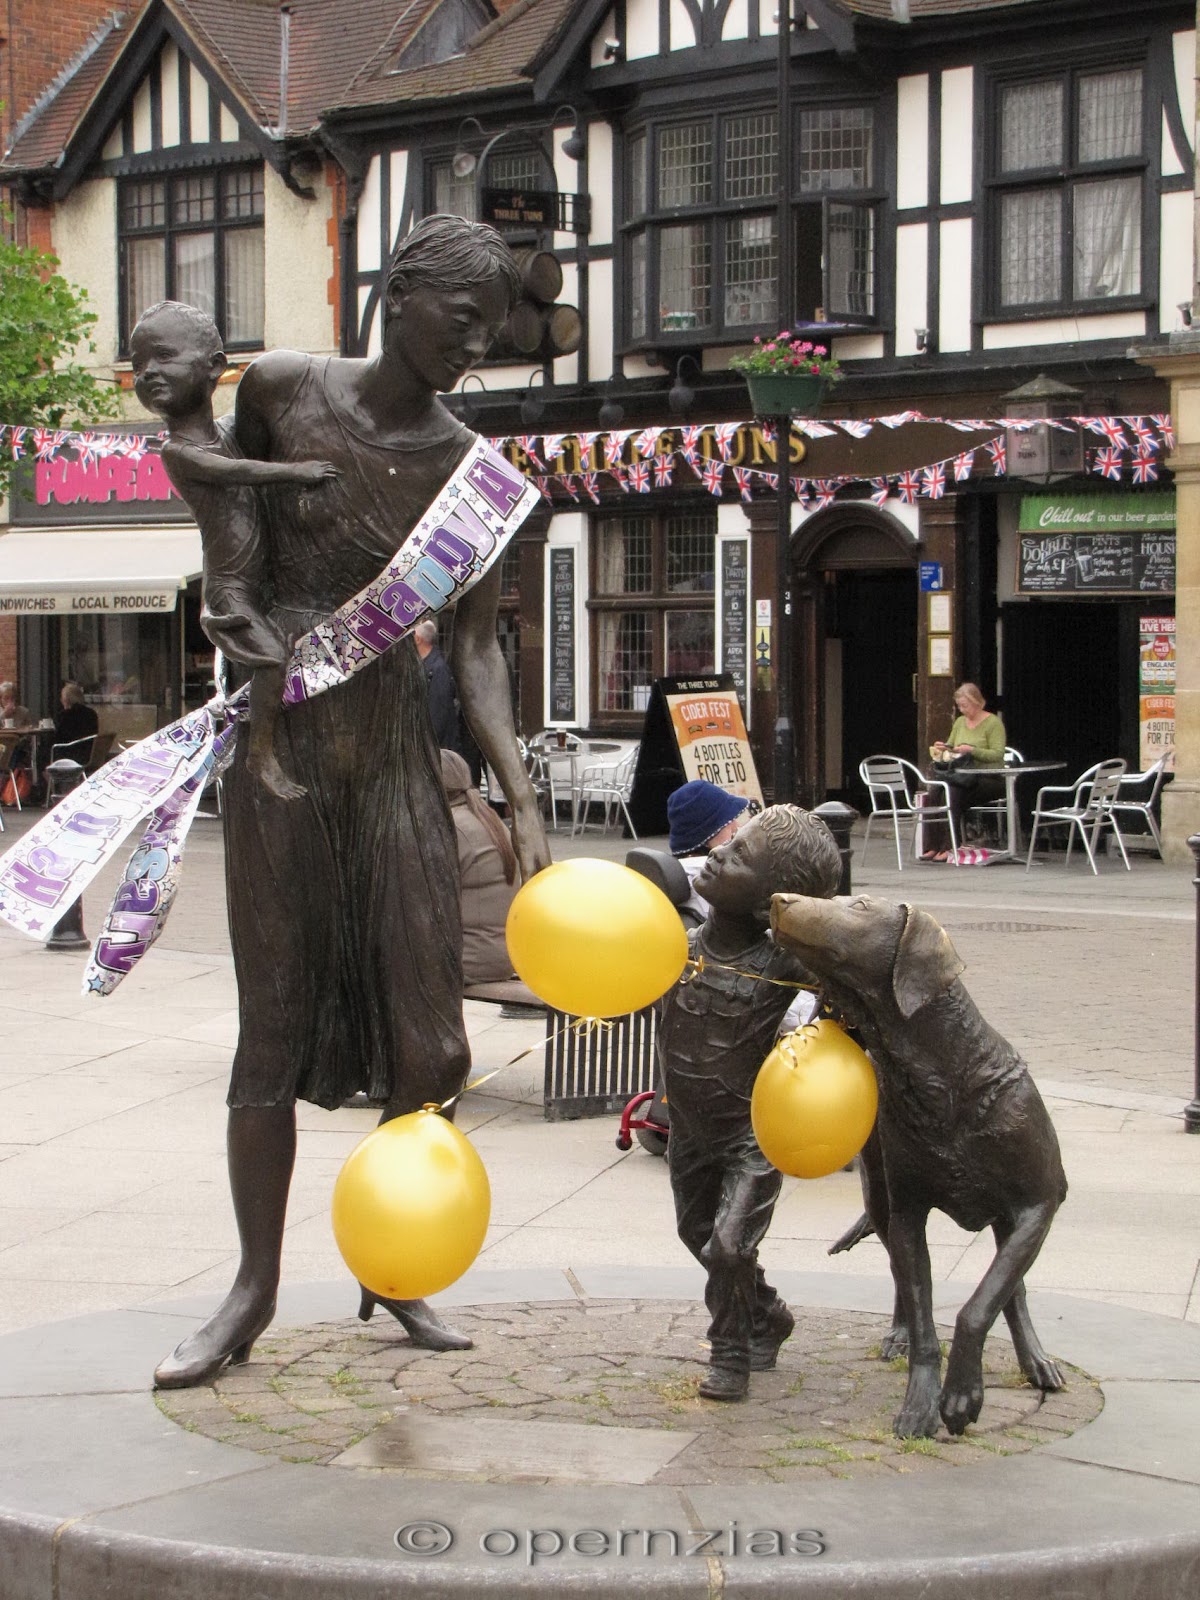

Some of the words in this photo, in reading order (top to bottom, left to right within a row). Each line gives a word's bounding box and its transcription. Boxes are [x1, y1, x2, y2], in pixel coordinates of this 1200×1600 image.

[1039, 506, 1073, 526] Chill
[1073, 509, 1095, 522] out
[1097, 512, 1106, 522] in
[1108, 514, 1124, 522] our
[1125, 512, 1146, 522] beer
[343, 498, 497, 655] Happy
[72, 597, 109, 609] LOCAL
[114, 595, 167, 608] PRODUCE
[1140, 624, 1159, 632] LIVE
[676, 681, 688, 690] THE
[688, 681, 704, 689] THREE
[705, 680, 719, 688] TUNS
[680, 702, 709, 722] CIDER
[709, 701, 731, 719] FEST
[1147, 732, 1161, 745] FOR
[694, 745, 701, 762] 4
[702, 742, 742, 762] BOTTLES
[697, 763, 723, 784] FOR
[725, 761, 747, 784] £10
